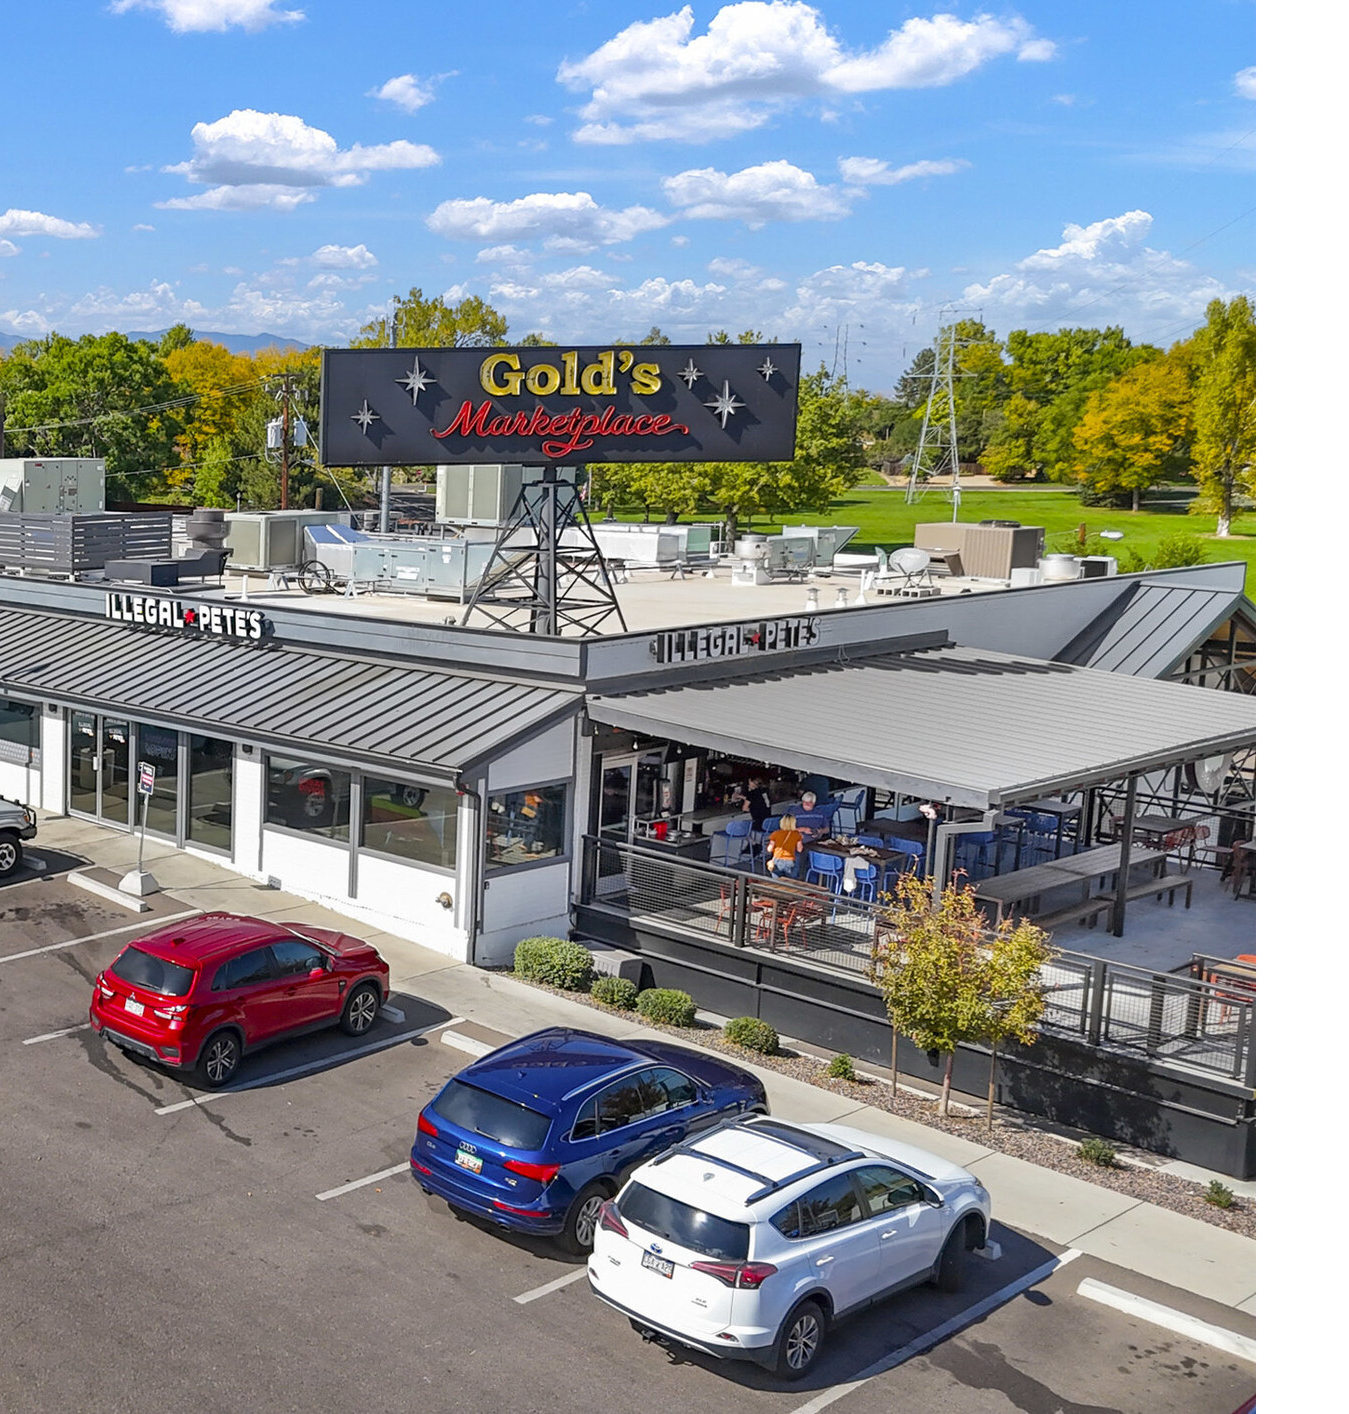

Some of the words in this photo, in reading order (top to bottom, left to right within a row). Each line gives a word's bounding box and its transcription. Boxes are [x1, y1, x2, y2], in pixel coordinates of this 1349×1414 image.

[479, 350, 662, 397] Gold's
[429, 399, 689, 458] Marketplace
[105, 593, 184, 628] ILLEGAL
[199, 605, 262, 639] PETE'S
[661, 625, 749, 664] ILLEGAL
[763, 616, 822, 651] PETE'S
